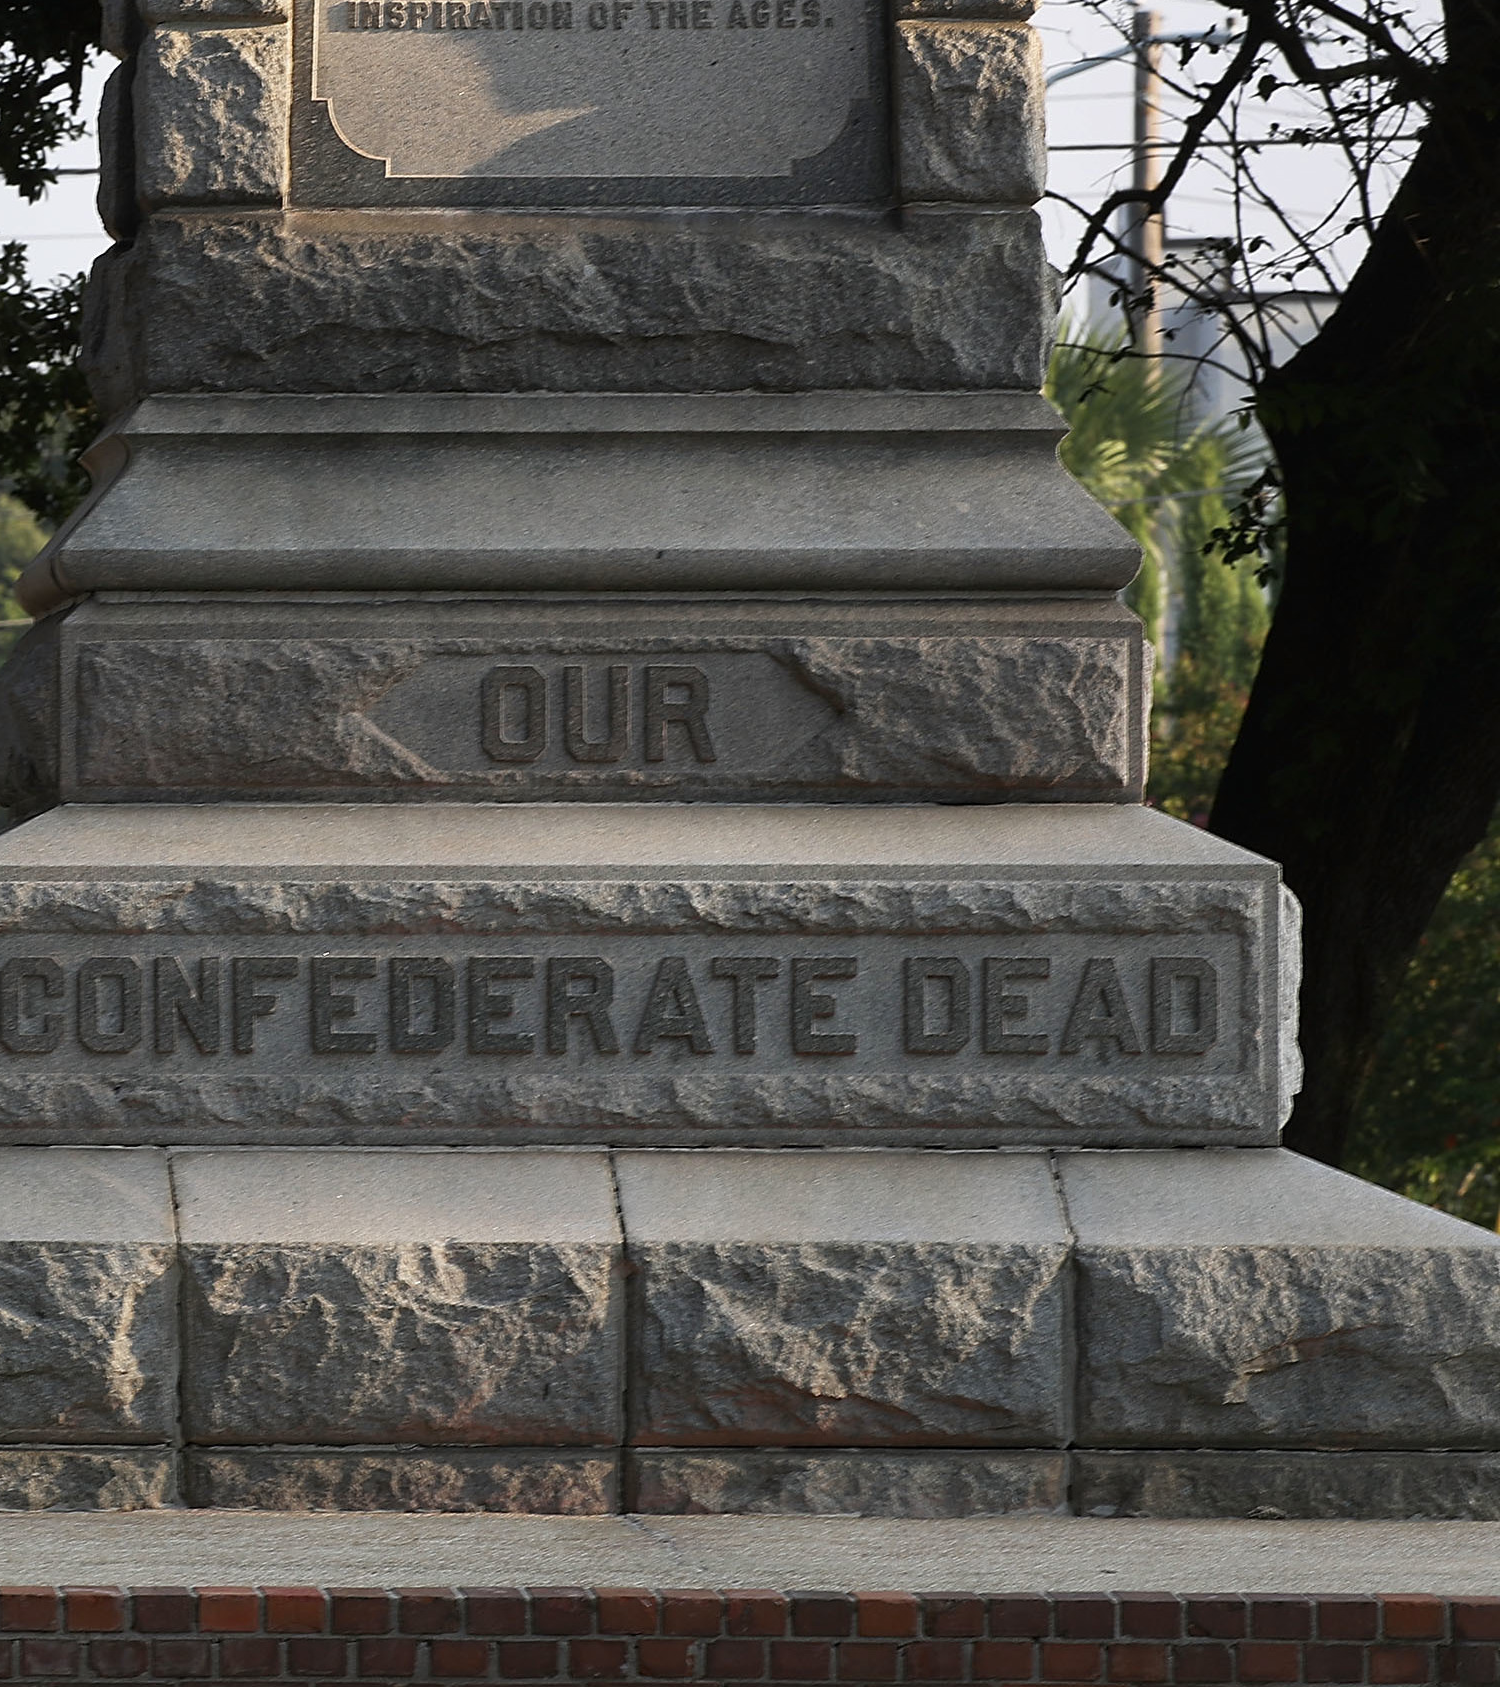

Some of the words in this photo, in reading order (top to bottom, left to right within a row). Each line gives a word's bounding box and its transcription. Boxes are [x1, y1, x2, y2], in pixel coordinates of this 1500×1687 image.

[347, 1, 573, 29] INSPIRATION
[587, 1, 633, 30] OF
[645, 1, 714, 30] THE
[727, 1, 834, 30] AGES.
[481, 665, 717, 763] OUR
[0, 956, 859, 1055] CONFEDERATE
[903, 956, 1218, 1055] DEAD
